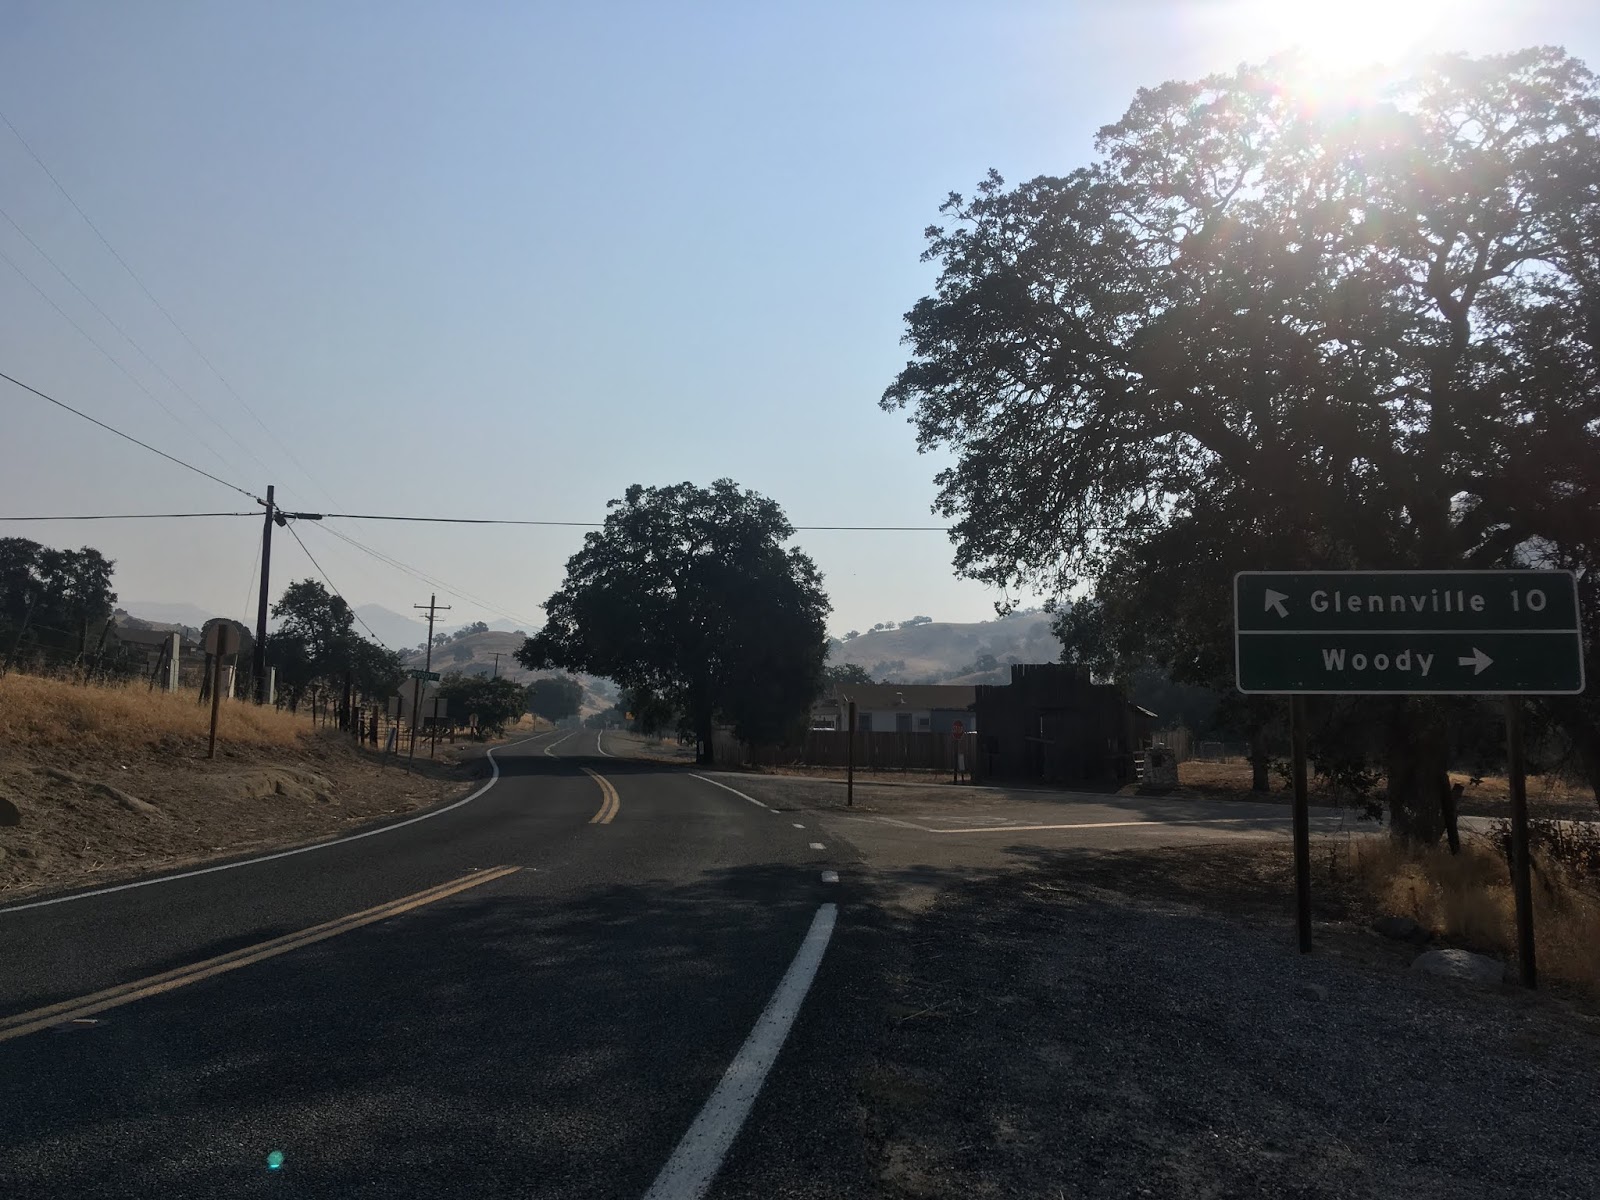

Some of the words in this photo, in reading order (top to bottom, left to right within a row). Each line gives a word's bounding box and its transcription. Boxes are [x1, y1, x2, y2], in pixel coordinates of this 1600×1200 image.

[1311, 590, 1485, 613] Glennville
[1511, 589, 1546, 612] 10
[1322, 648, 1434, 676] Woody
